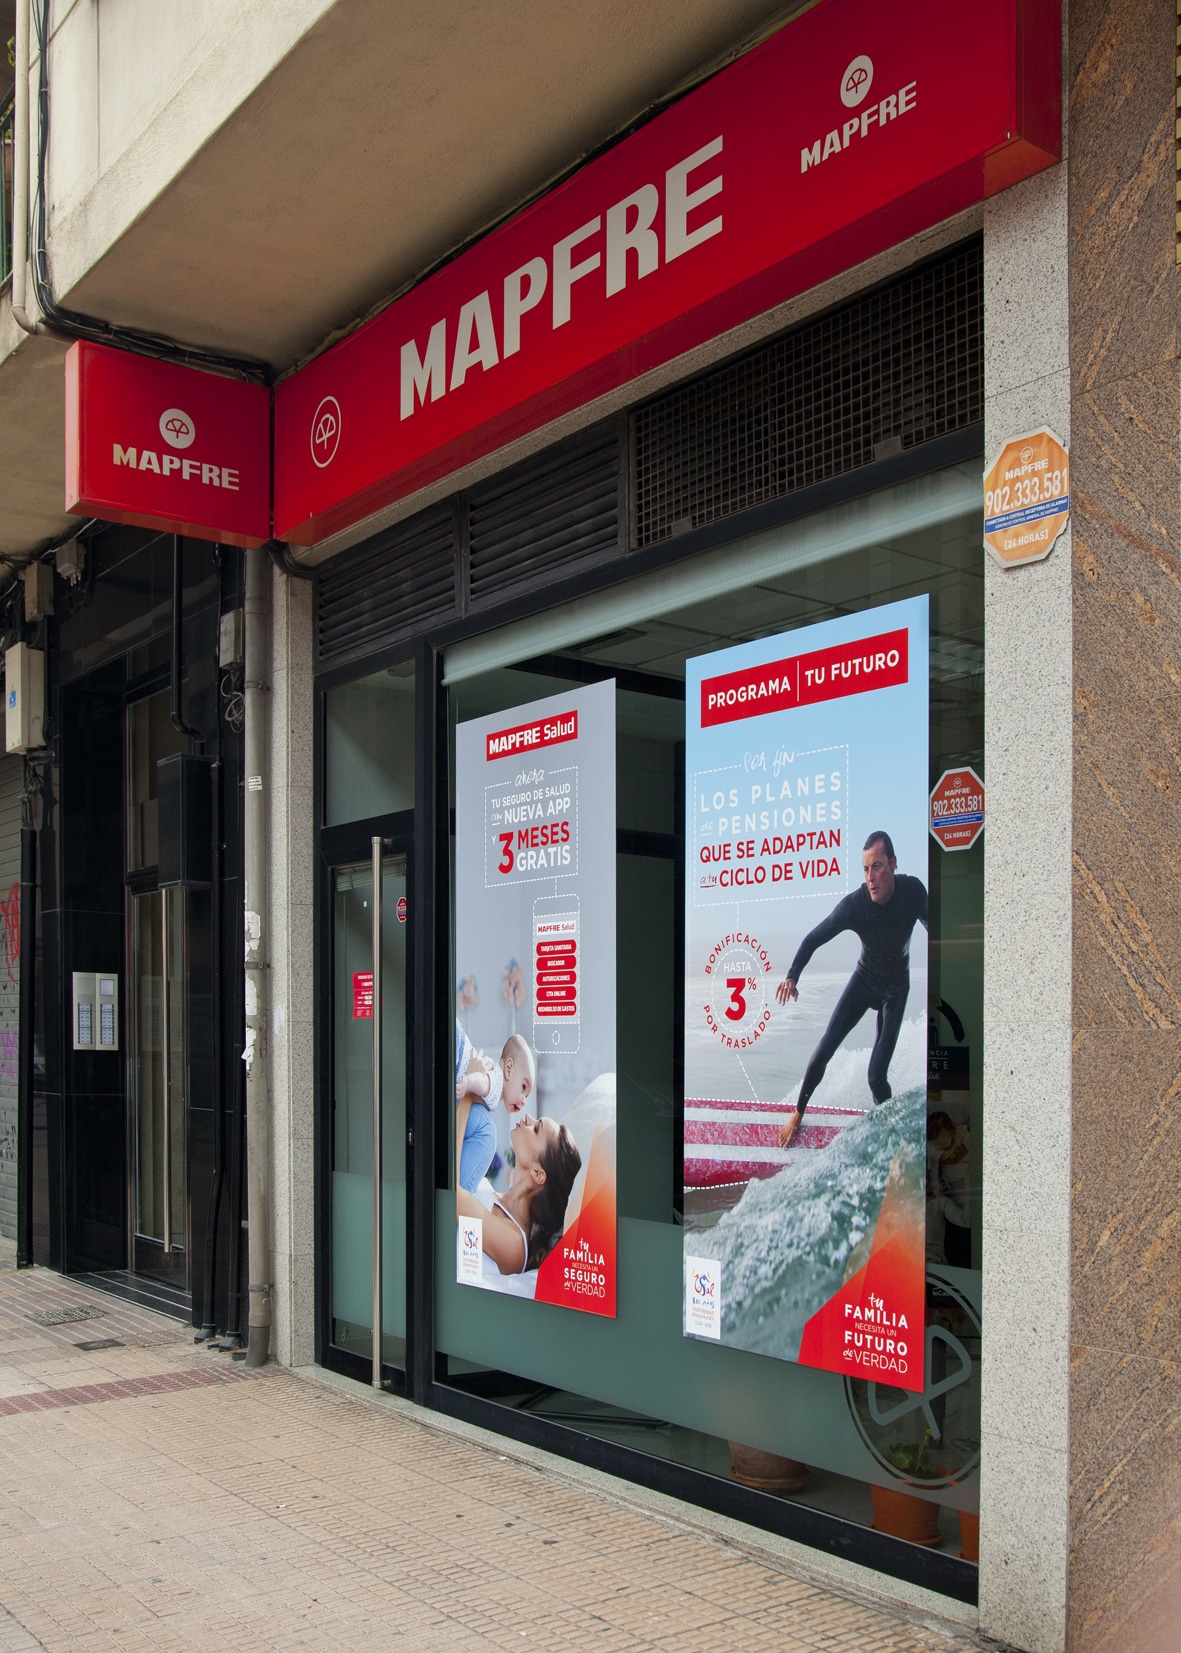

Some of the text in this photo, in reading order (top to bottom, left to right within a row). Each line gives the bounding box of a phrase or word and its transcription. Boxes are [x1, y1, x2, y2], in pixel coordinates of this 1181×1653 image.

[801, 80, 917, 174] MAPFRE
[399, 134, 723, 421] MAPFRE
[112, 443, 240, 491] MAPFRE
[1005, 458, 1049, 480] MAPFRE
[985, 467, 1068, 516] 902.333.581
[1019, 528, 1049, 546] HORAS]
[708, 649, 900, 710] PROGRAMA TU FUTURO
[489, 716, 575, 756] MAPFRE Salud
[514, 768, 545, 787] ahora
[491, 783, 571, 809] TU SEGURO DE SALUD
[701, 771, 841, 813] LOS PLANES
[944, 787, 971, 797] MAPFRE
[504, 802, 544, 825] NUEVA
[546, 797, 571, 817] APP
[718, 800, 842, 837] PENSIONES
[933, 794, 982, 817] 902.333.581
[491, 820, 570, 874] Y 3 MESES
[516, 844, 571, 873] GRATIS
[700, 828, 841, 864] QUE SE ADAPTAN
[719, 865, 766, 888] CICLO
[772, 862, 794, 883] DE
[799, 857, 841, 879] VIDA
[538, 922, 575, 933] MAPFRE Salud
[704, 932, 772, 975] BONIFICACIÓN
[723, 961, 752, 973] HASTA
[703, 1004, 718, 1035] POR
[563, 1248, 606, 1266] FAMILIA
[579, 1237, 589, 1252] tu
[563, 1268, 606, 1286] SEGURO
[571, 1262, 599, 1273] NECESITA UN
[571, 1281, 606, 1298] VERDAD
[868, 1292, 884, 1311] tu
[844, 1303, 908, 1330] FAMILIA
[855, 1322, 896, 1337] NECESITA UN
[844, 1330, 908, 1356] FUTURO
[853, 1349, 908, 1374] VERDAD
